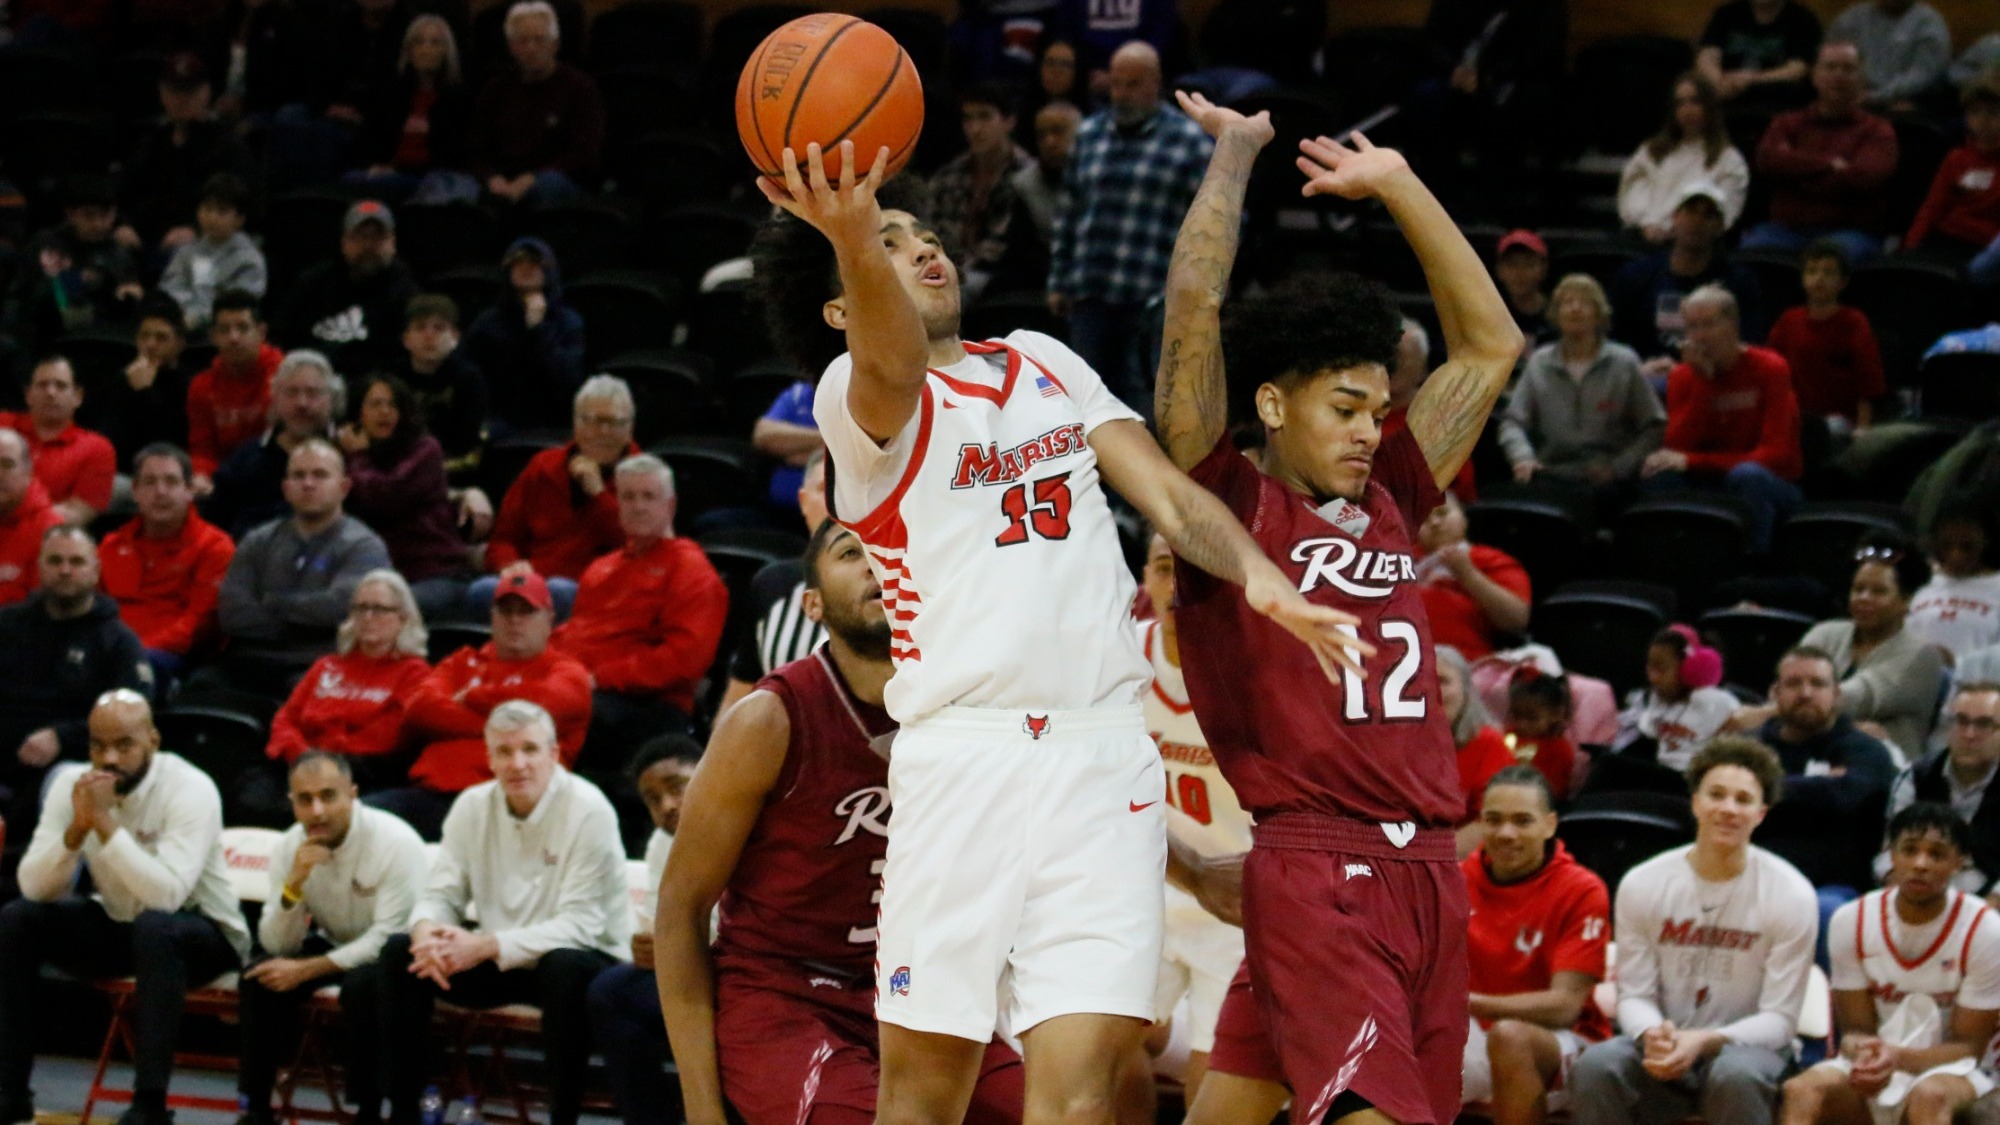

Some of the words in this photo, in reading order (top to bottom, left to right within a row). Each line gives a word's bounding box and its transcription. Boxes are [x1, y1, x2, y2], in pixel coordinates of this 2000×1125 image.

[950, 422, 1087, 490] MARIST
[995, 471, 1073, 548] 15
[1334, 620, 1427, 720] 12
[1149, 731, 1215, 766] ARIS
[1344, 863, 1372, 881] MAAC
